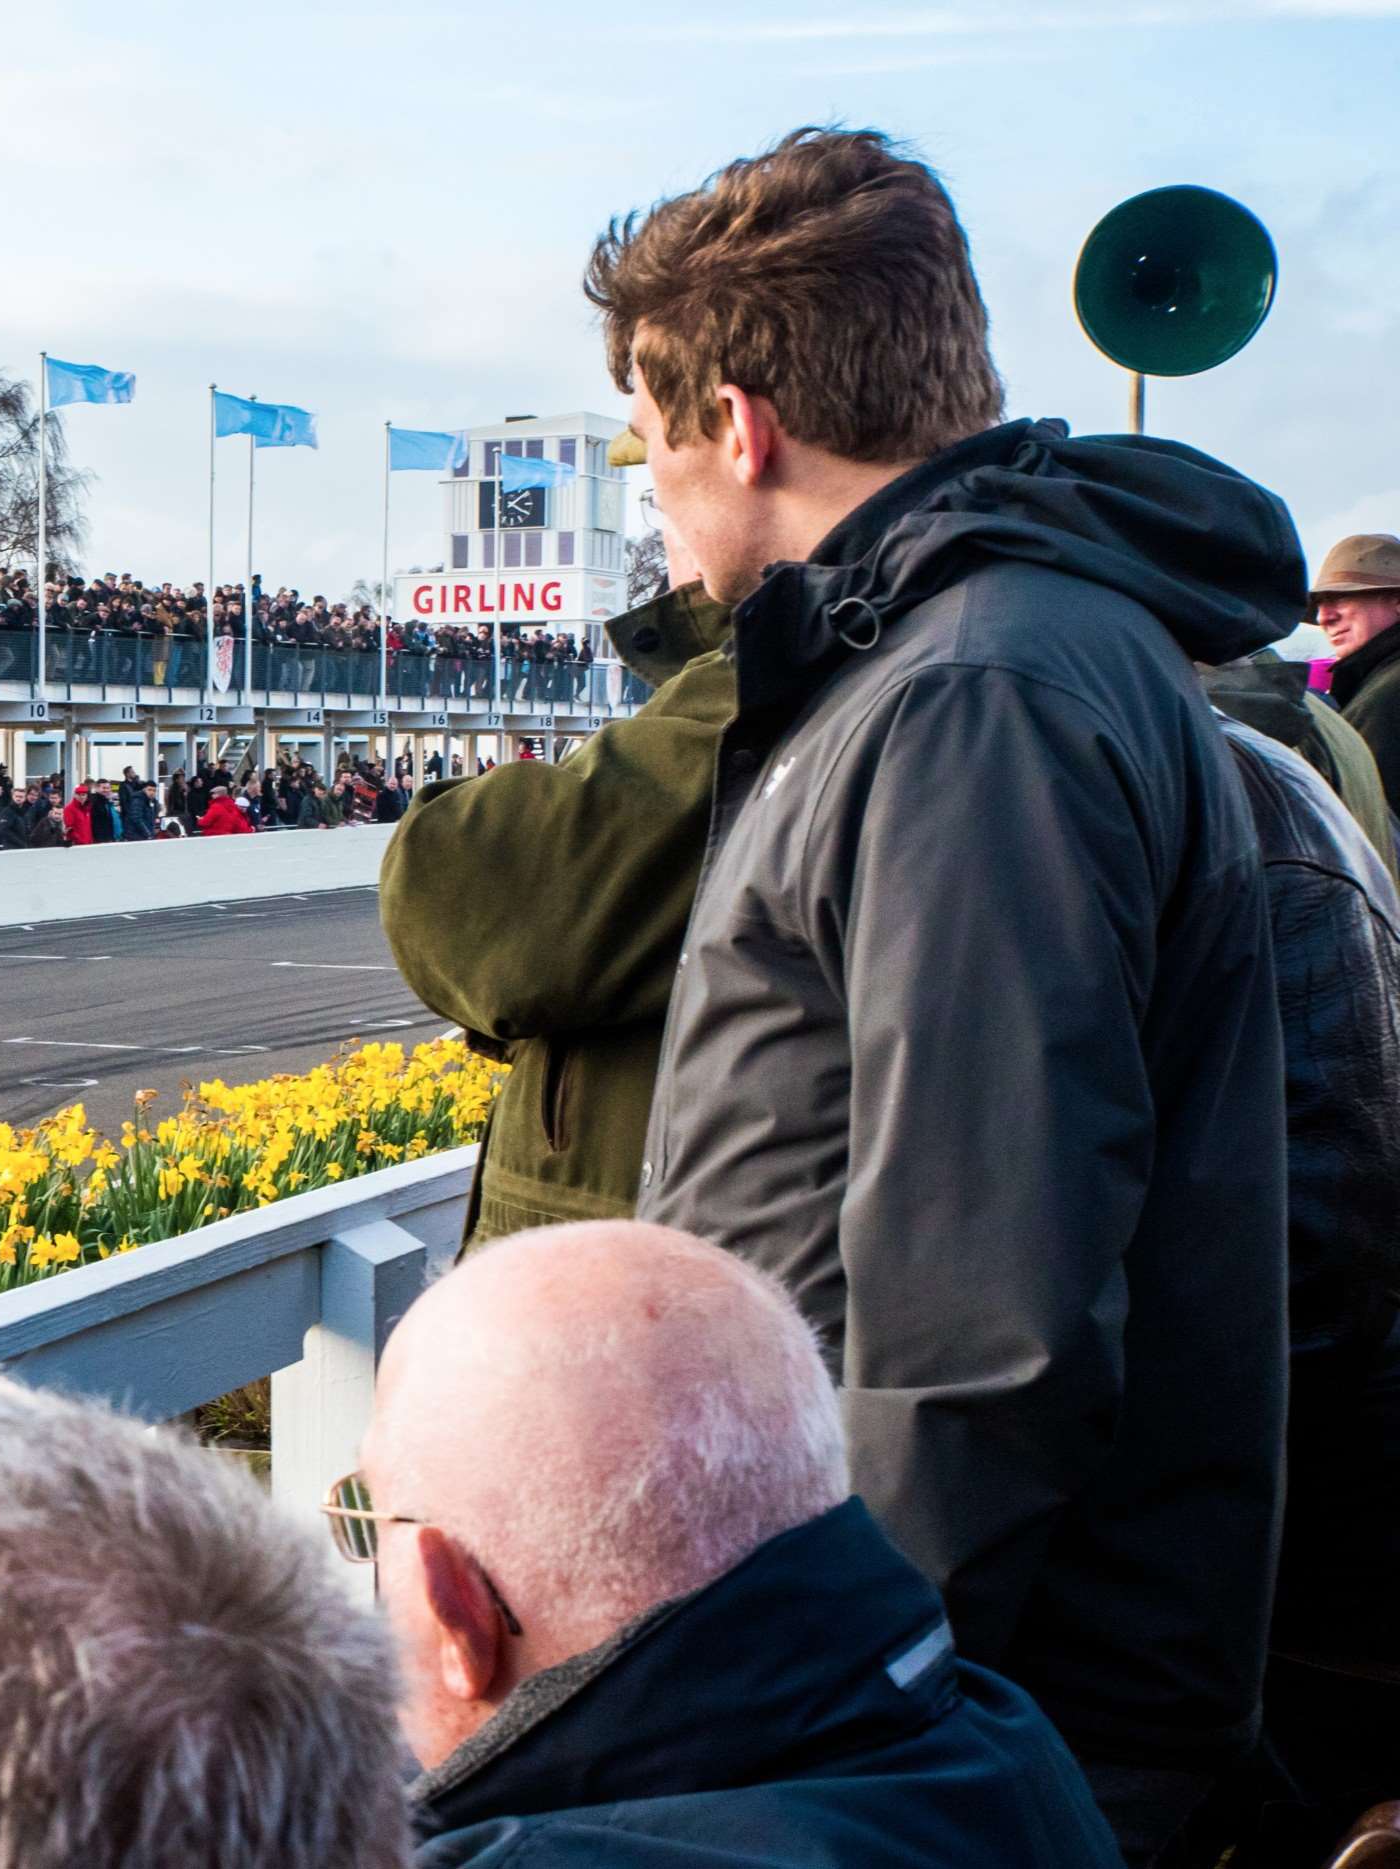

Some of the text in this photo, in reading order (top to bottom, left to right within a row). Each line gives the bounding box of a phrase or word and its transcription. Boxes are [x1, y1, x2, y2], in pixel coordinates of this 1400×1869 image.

[412, 581, 563, 614] GIRLING
[29, 703, 46, 718] 10
[121, 706, 135, 719] 11
[199, 707, 215, 721] 12
[306, 710, 321, 723] 14
[372, 712, 387, 724] 15
[431, 714, 446, 725] 16
[487, 715, 501, 726] 17
[539, 716, 553, 727] 18
[587, 717, 601, 728] 19
